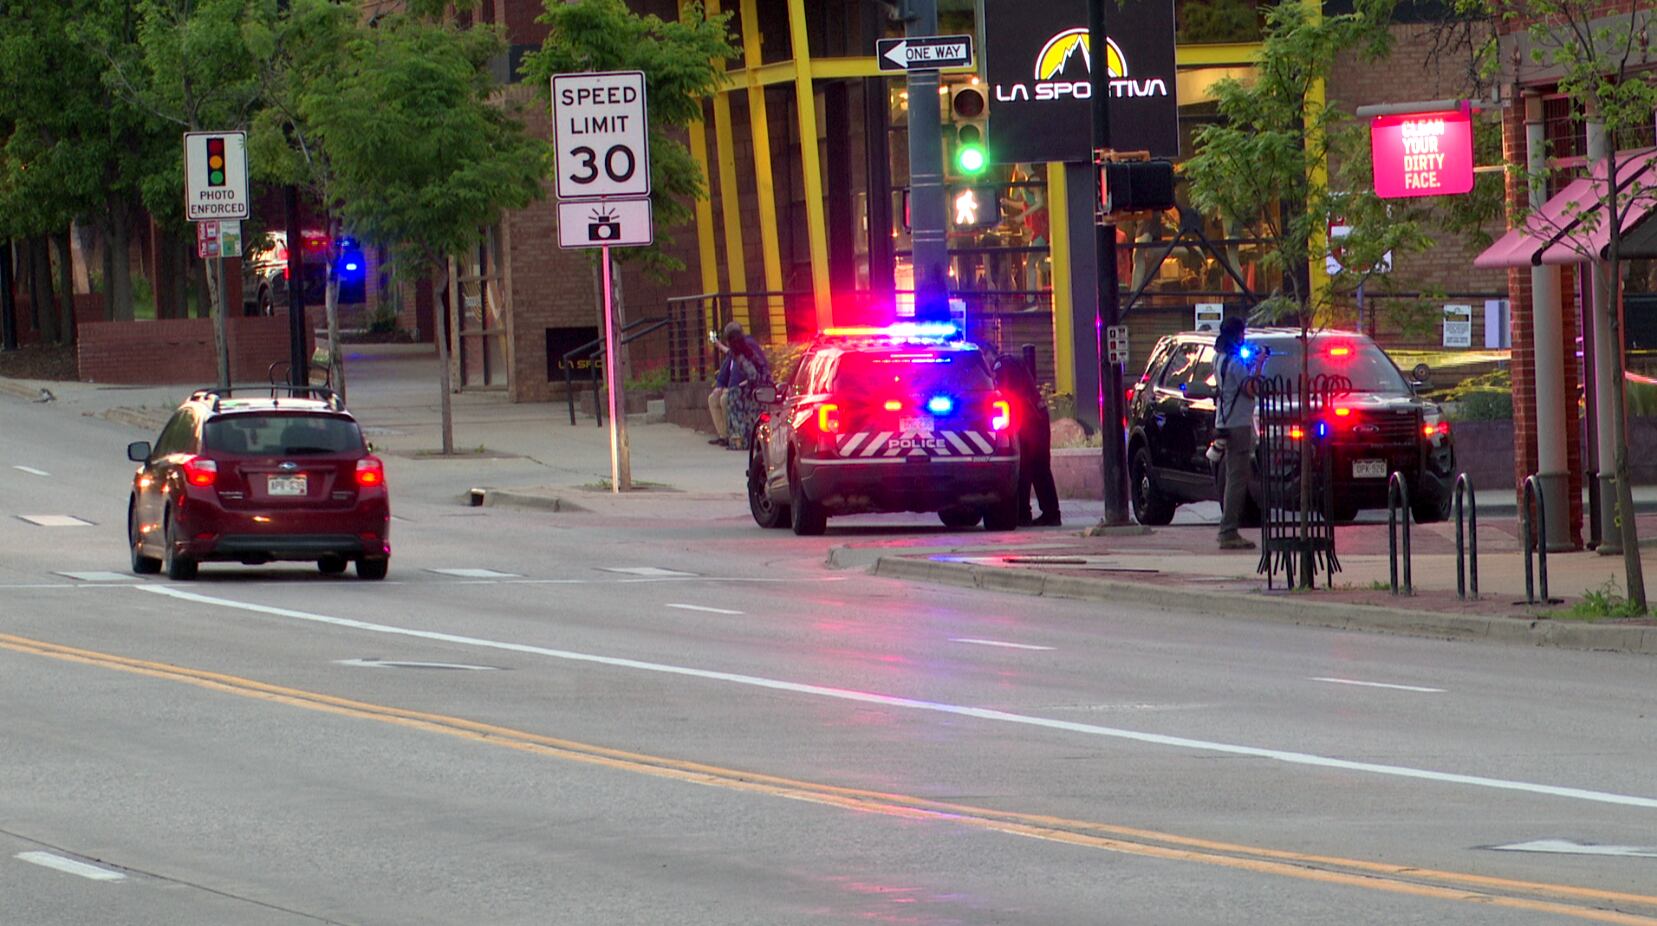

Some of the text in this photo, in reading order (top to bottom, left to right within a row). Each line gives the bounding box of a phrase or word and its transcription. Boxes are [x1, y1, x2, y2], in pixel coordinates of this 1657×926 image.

[905, 45, 961, 60] ONE WAY
[561, 86, 637, 106] SPEED
[996, 79, 1168, 101] LA SPOTIVA
[570, 115, 629, 135] LIMIT
[1402, 136, 1438, 154] YOUR
[569, 144, 636, 185] 30
[1404, 153, 1445, 171] DIRTY
[1405, 171, 1441, 189] FACE.
[200, 189, 235, 200] PHOTO
[191, 203, 245, 214] ENFORCED
[888, 439, 946, 449] POLICE
